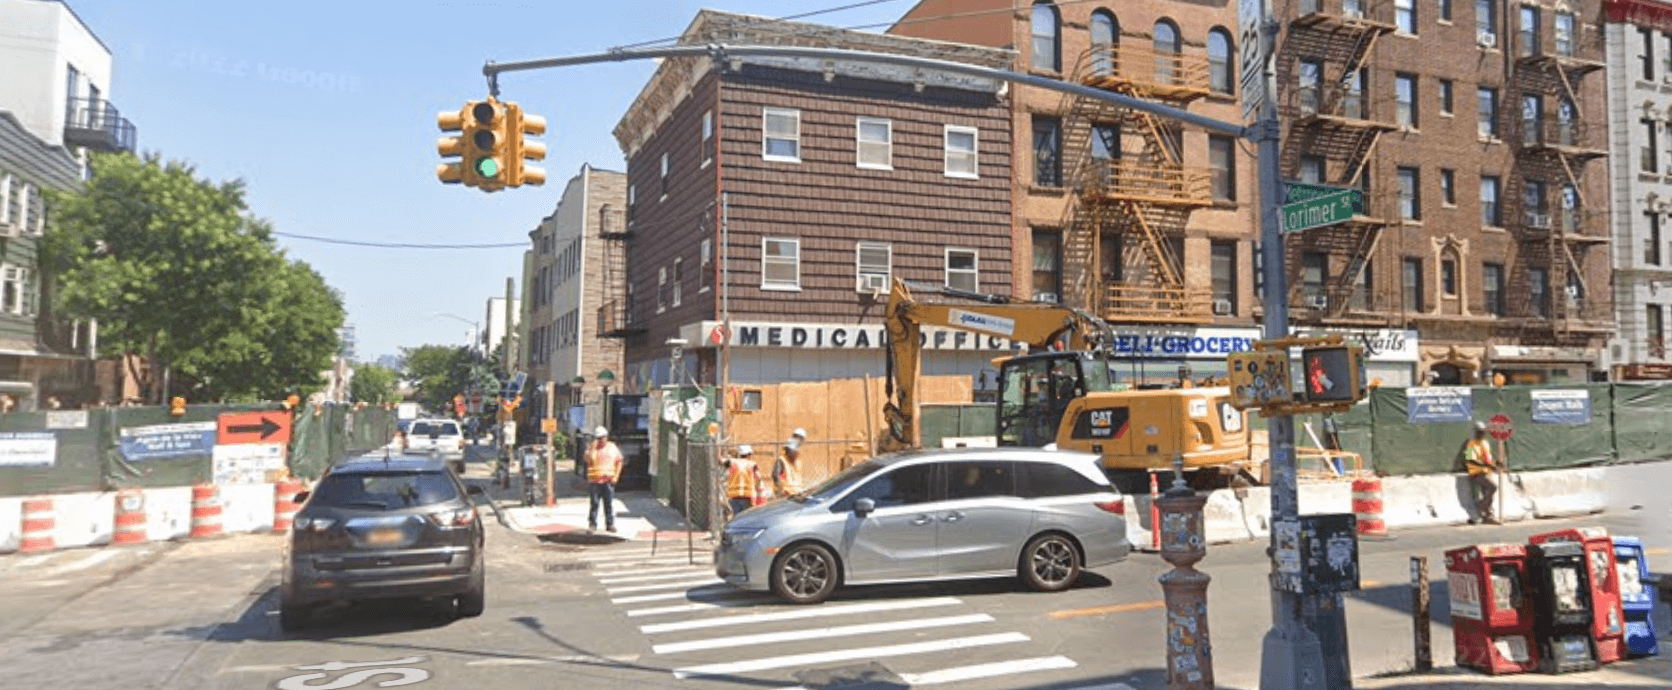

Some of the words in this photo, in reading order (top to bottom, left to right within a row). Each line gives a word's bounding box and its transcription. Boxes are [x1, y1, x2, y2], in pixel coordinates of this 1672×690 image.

[1283, 202, 1338, 231] Lorimer
[740, 326, 887, 348] MEDICAL
[1090, 410, 1113, 427] CAT
